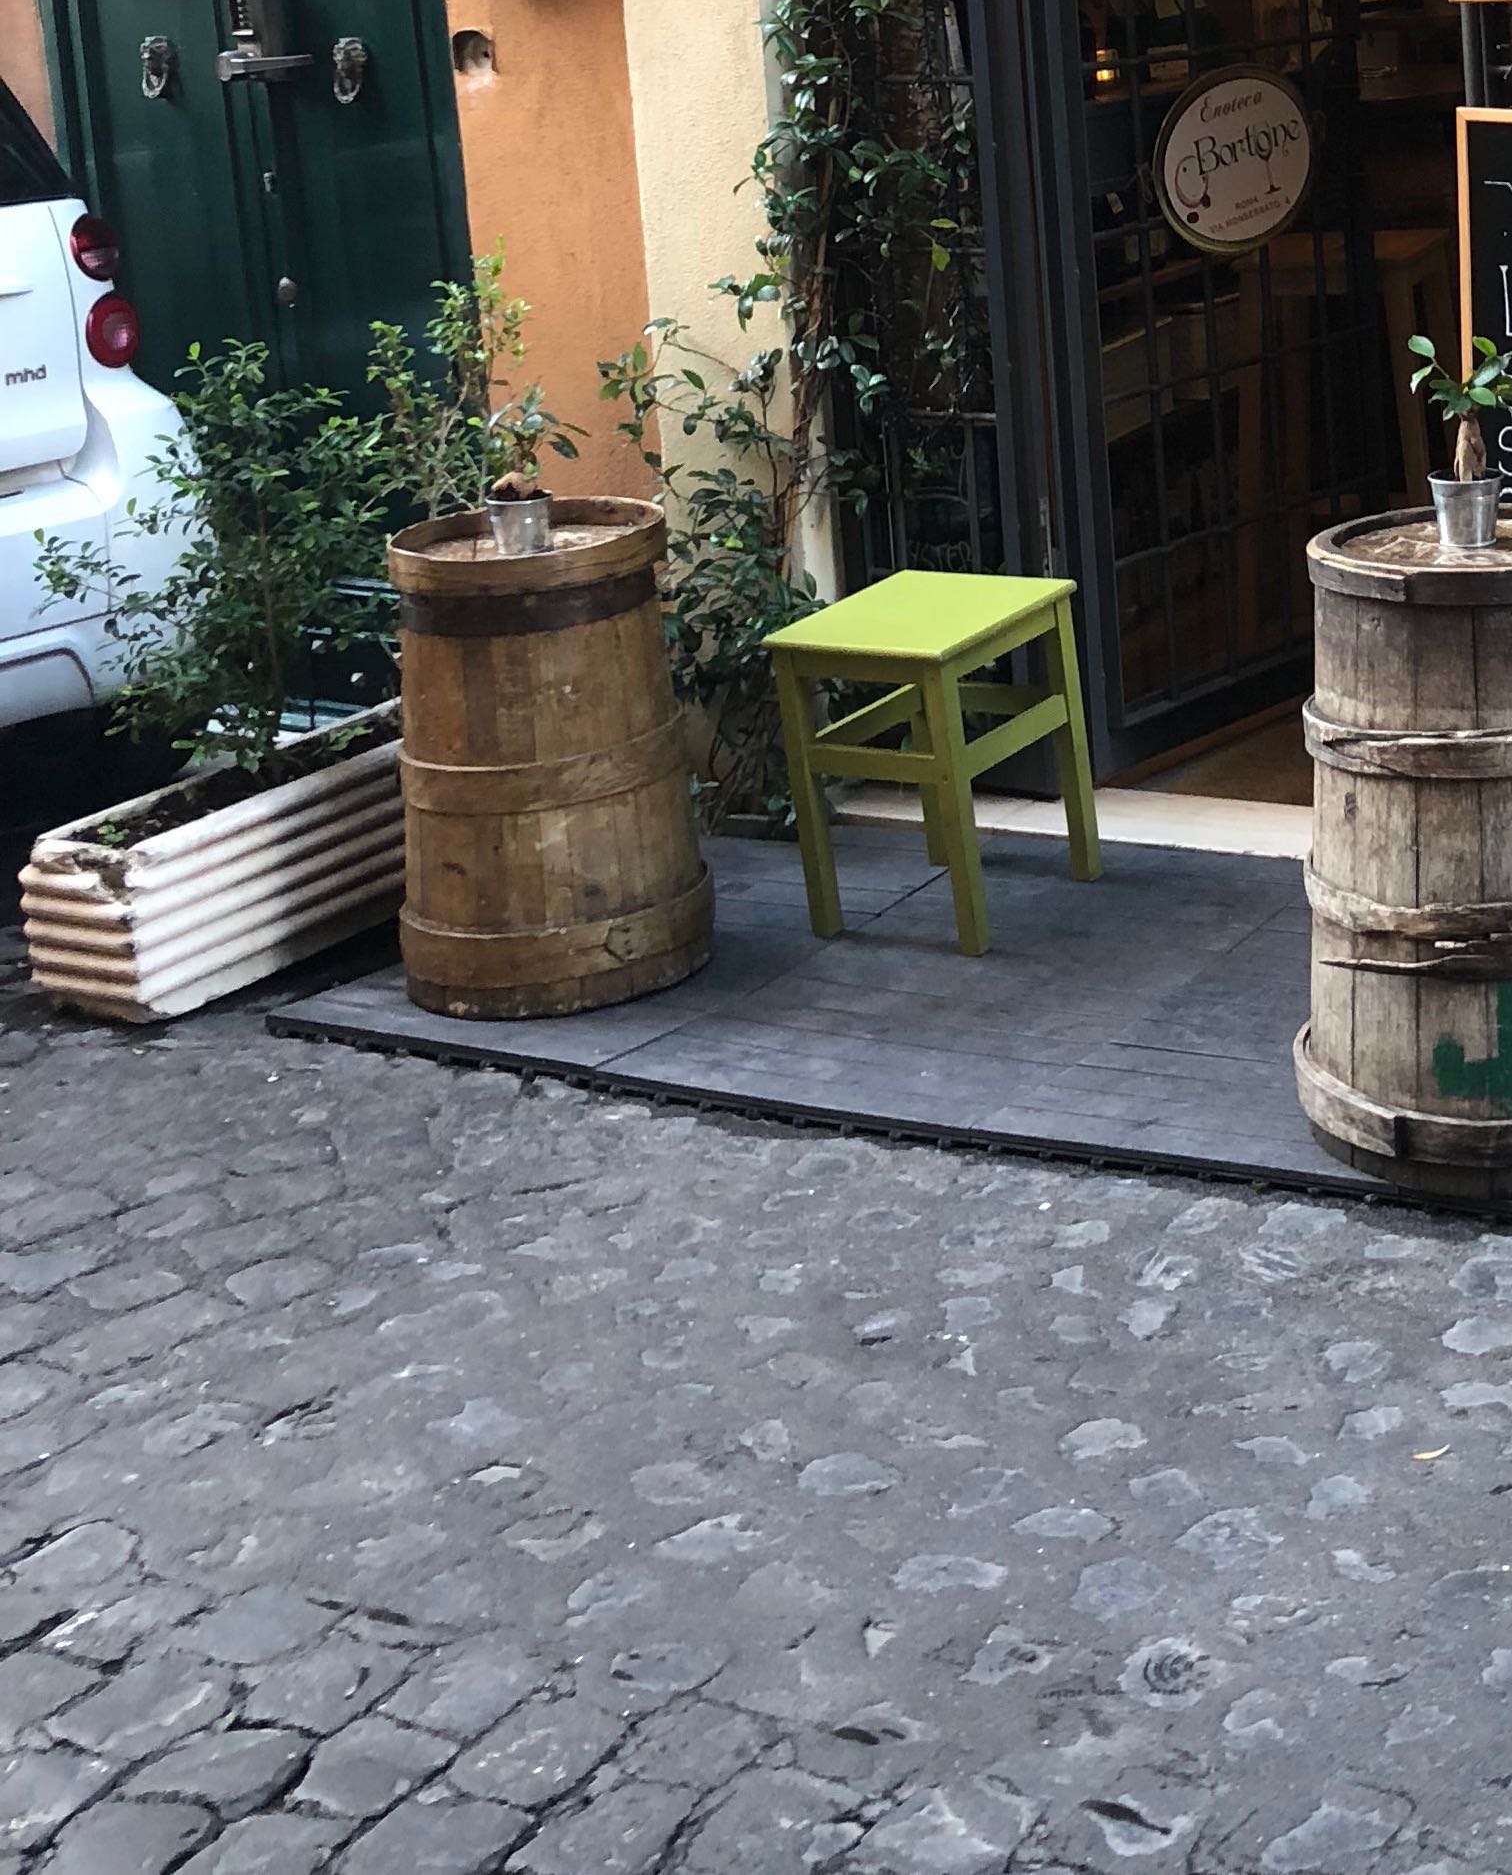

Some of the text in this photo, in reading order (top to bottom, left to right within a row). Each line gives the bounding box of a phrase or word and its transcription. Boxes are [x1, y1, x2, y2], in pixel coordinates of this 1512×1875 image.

[1200, 90, 1263, 123] Enoteca
[1193, 118, 1300, 176] Bortone
[1234, 196, 1259, 210] ROMA
[5, 363, 47, 386] mhd
